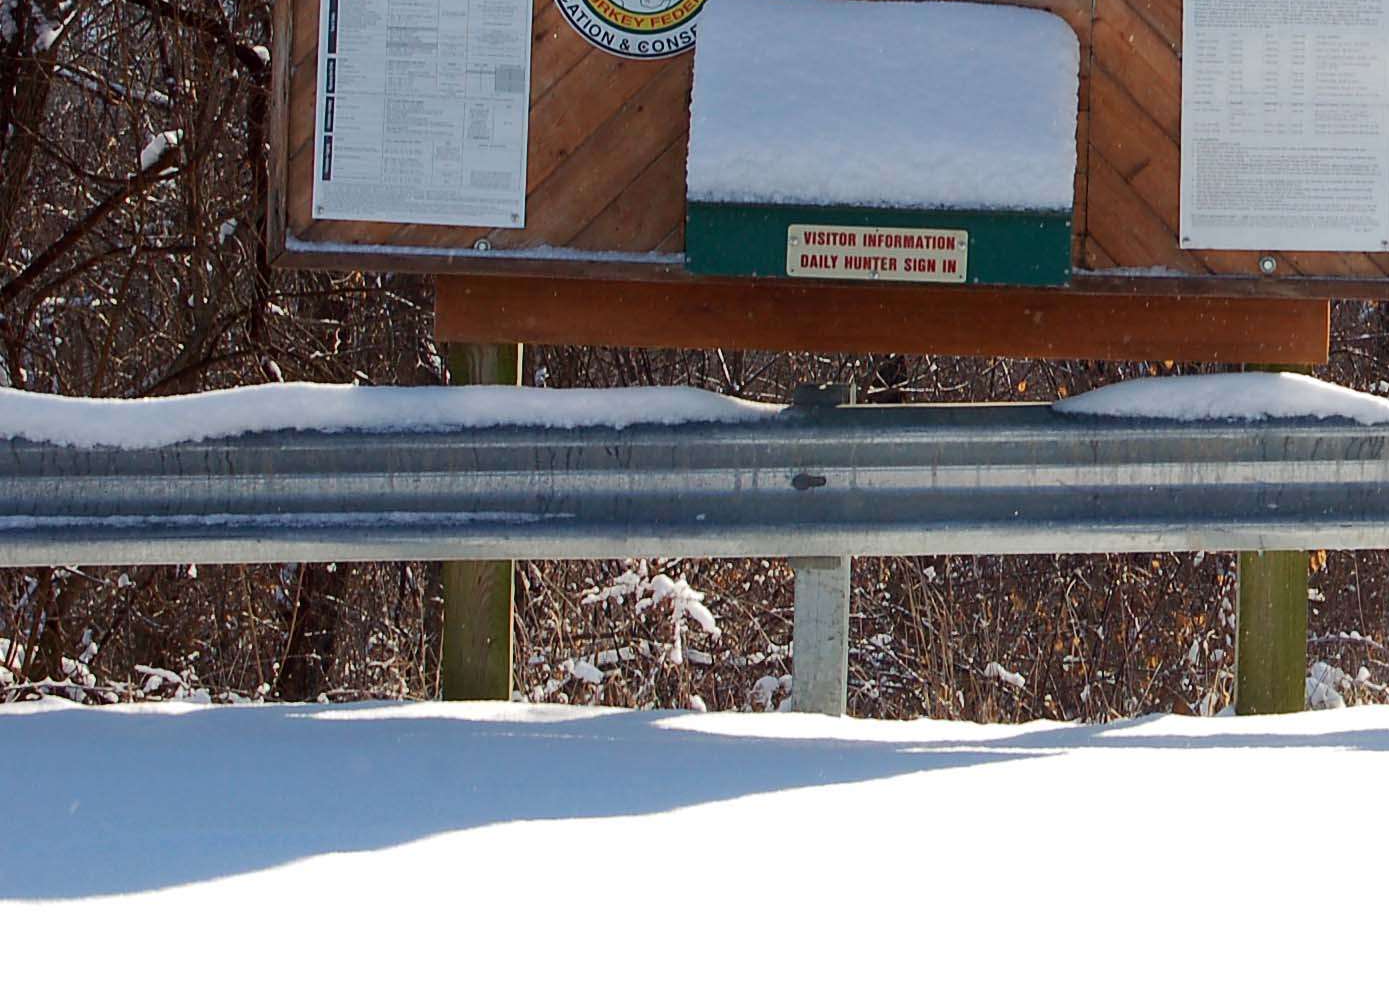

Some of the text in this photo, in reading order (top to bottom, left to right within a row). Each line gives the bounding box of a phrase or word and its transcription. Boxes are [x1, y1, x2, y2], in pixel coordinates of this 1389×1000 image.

[619, 38, 631, 50] &
[803, 231, 956, 250] VISITOR INFORMATION
[801, 254, 957, 273] DAILY HUNTER SIGN IN
